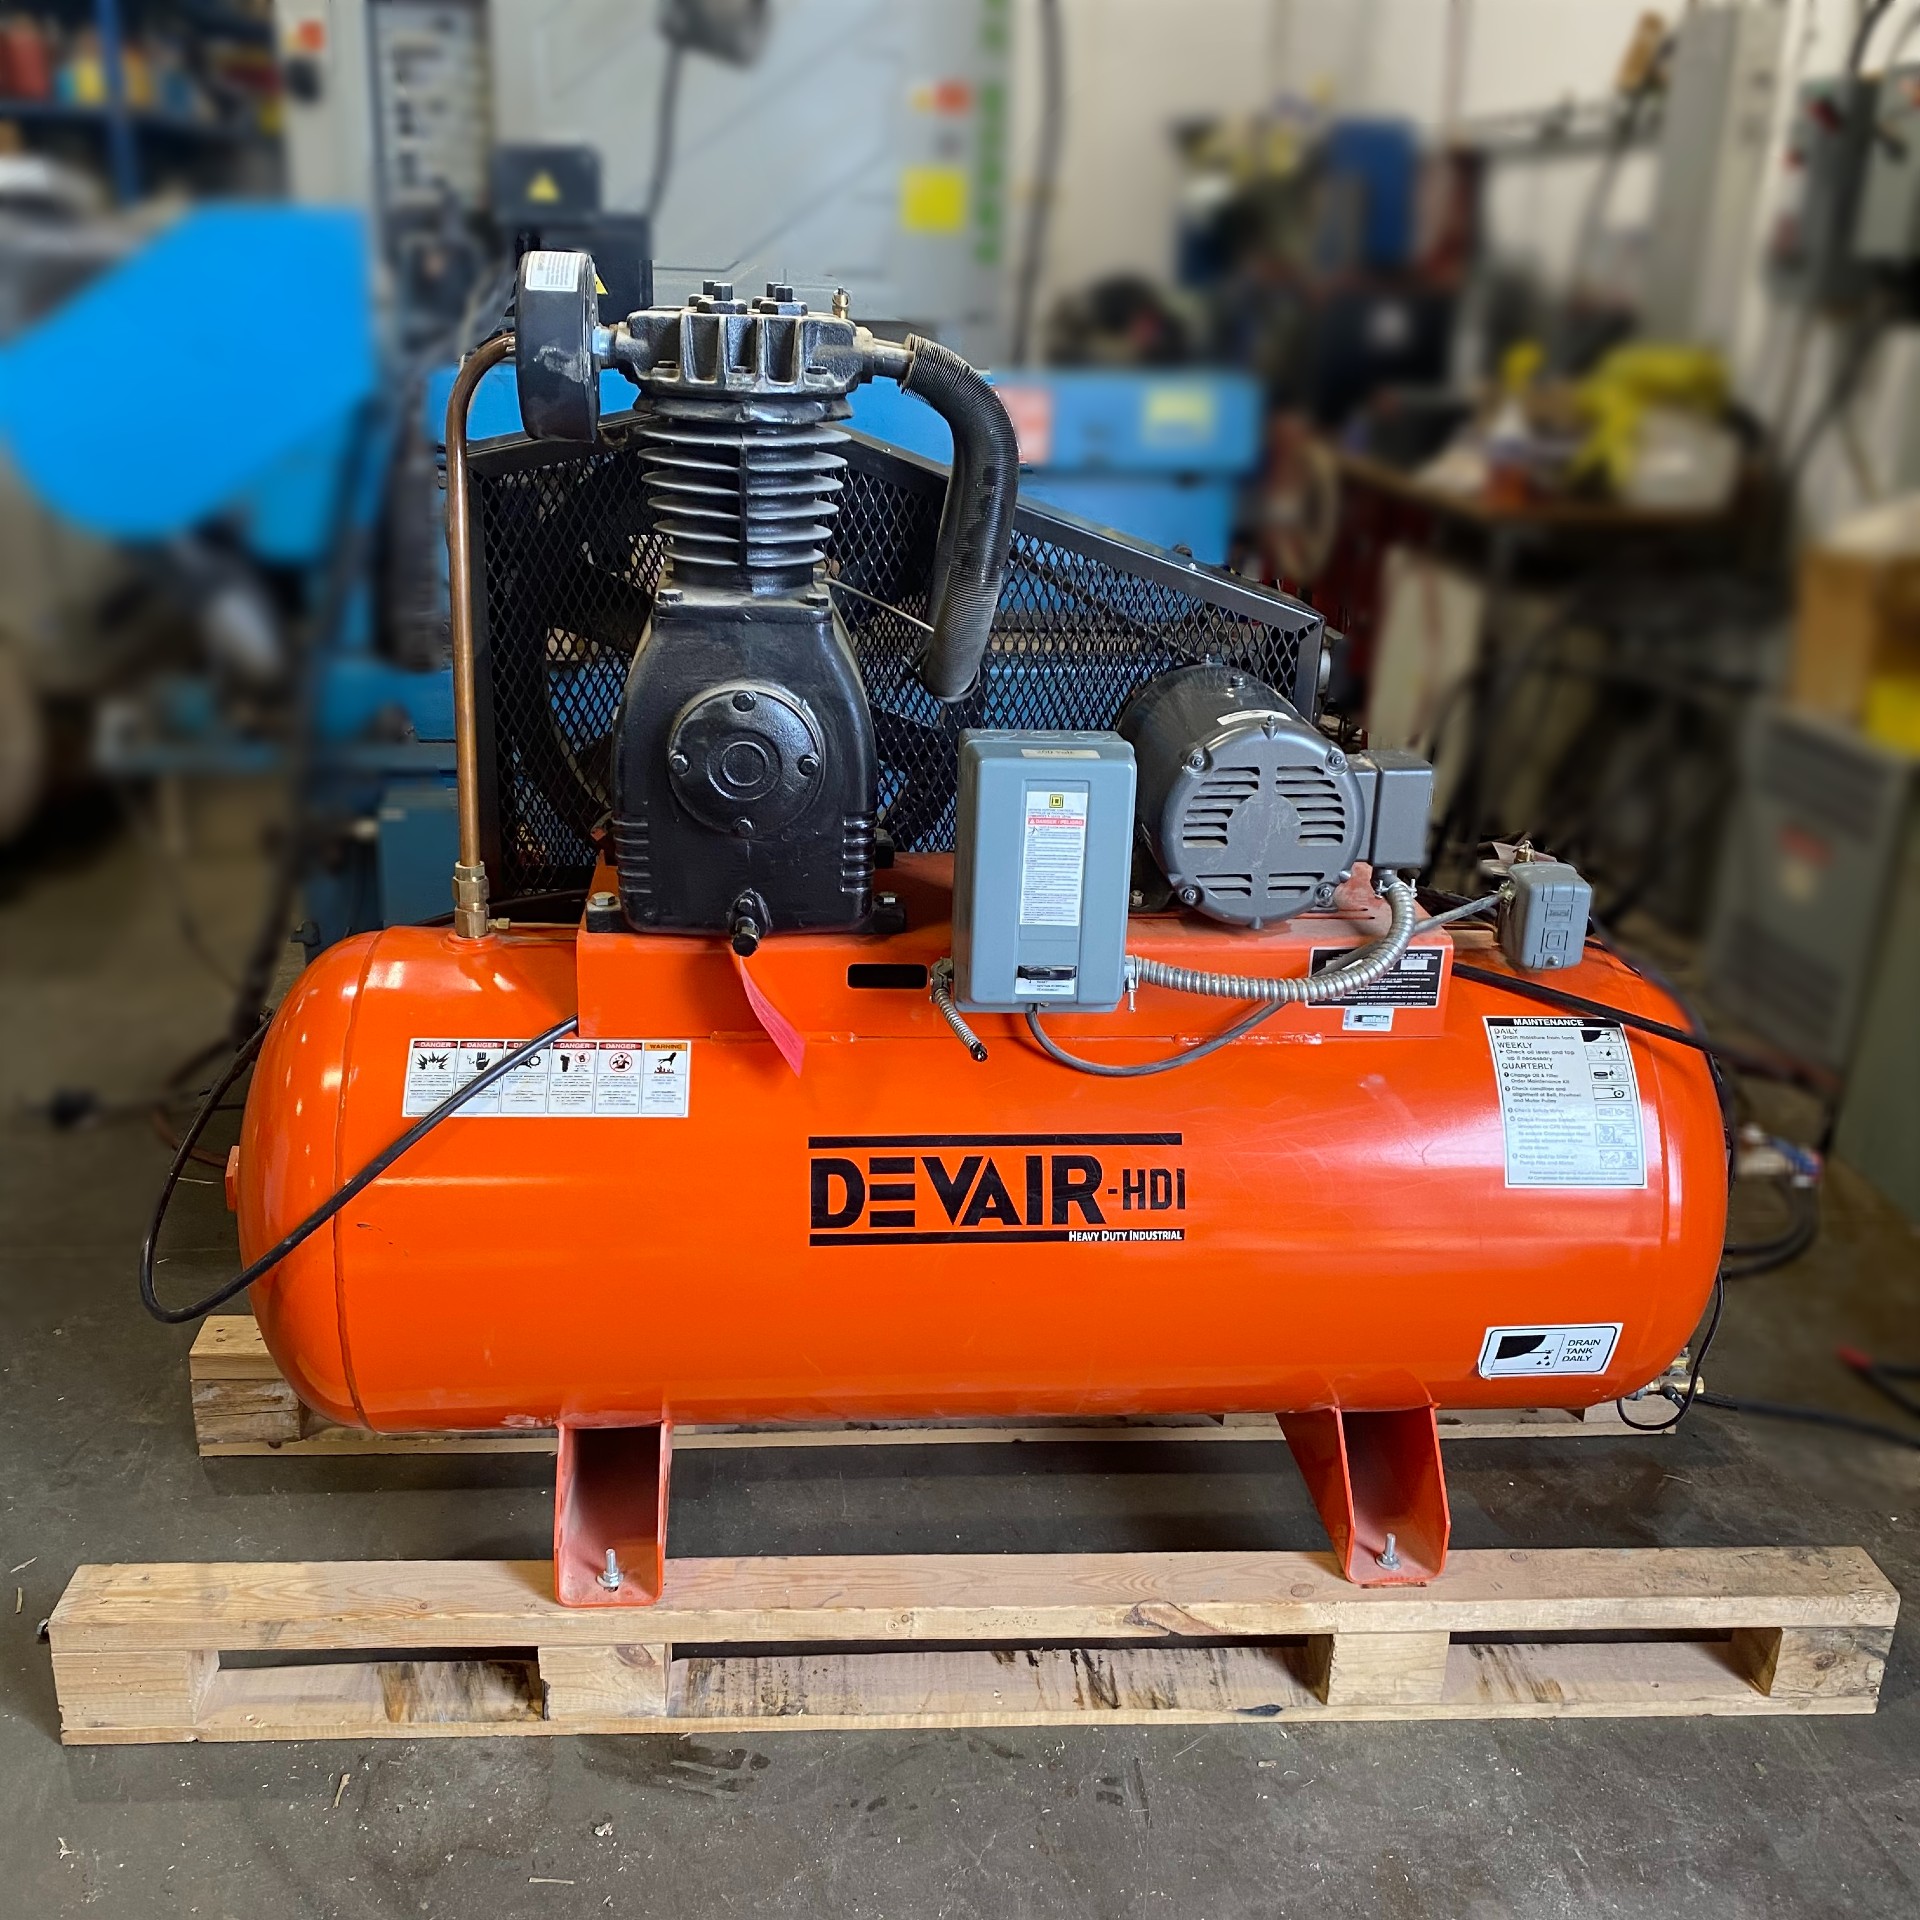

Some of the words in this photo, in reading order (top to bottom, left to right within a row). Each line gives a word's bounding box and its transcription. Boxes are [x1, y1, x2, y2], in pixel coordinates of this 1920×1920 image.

[1069, 1231, 1099, 1241] HEAVY
[1102, 1230, 1127, 1241] DUTY
[1130, 1230, 1182, 1240] INDUSTRIAL
